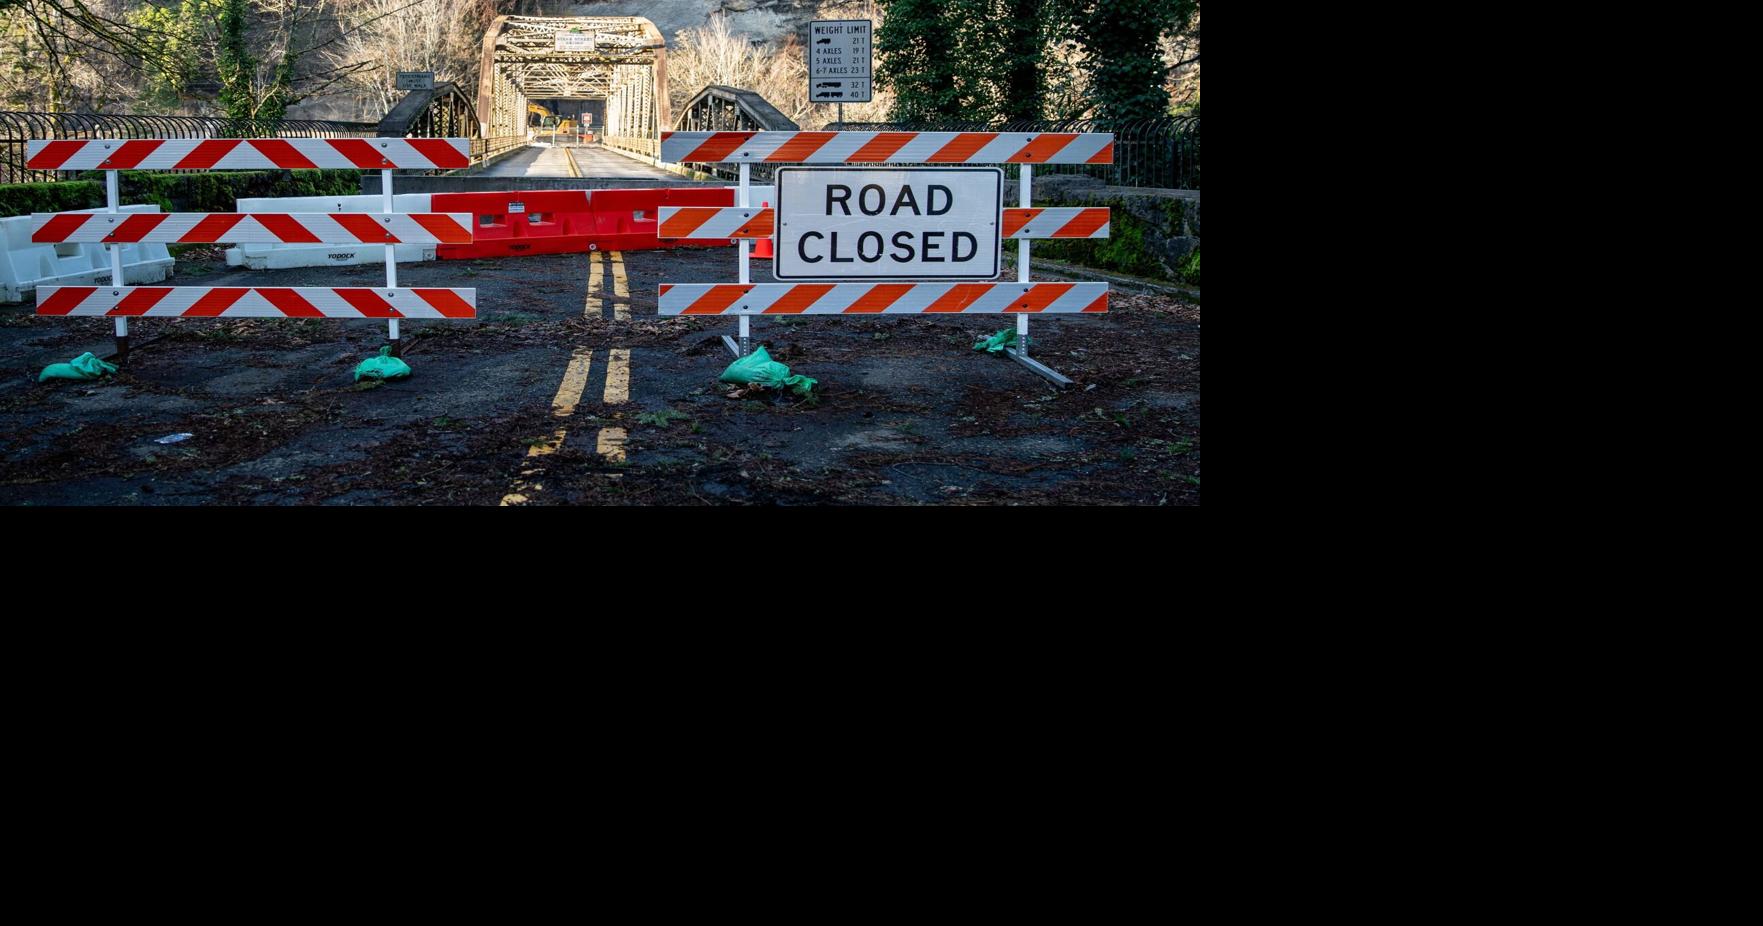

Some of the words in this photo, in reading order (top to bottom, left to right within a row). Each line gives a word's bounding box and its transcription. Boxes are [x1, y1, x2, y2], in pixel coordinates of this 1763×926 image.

[815, 26, 843, 34] WEIGHT
[847, 26, 866, 34] LIMIT
[826, 184, 953, 216] ROAD
[798, 230, 978, 264] CLOSED
